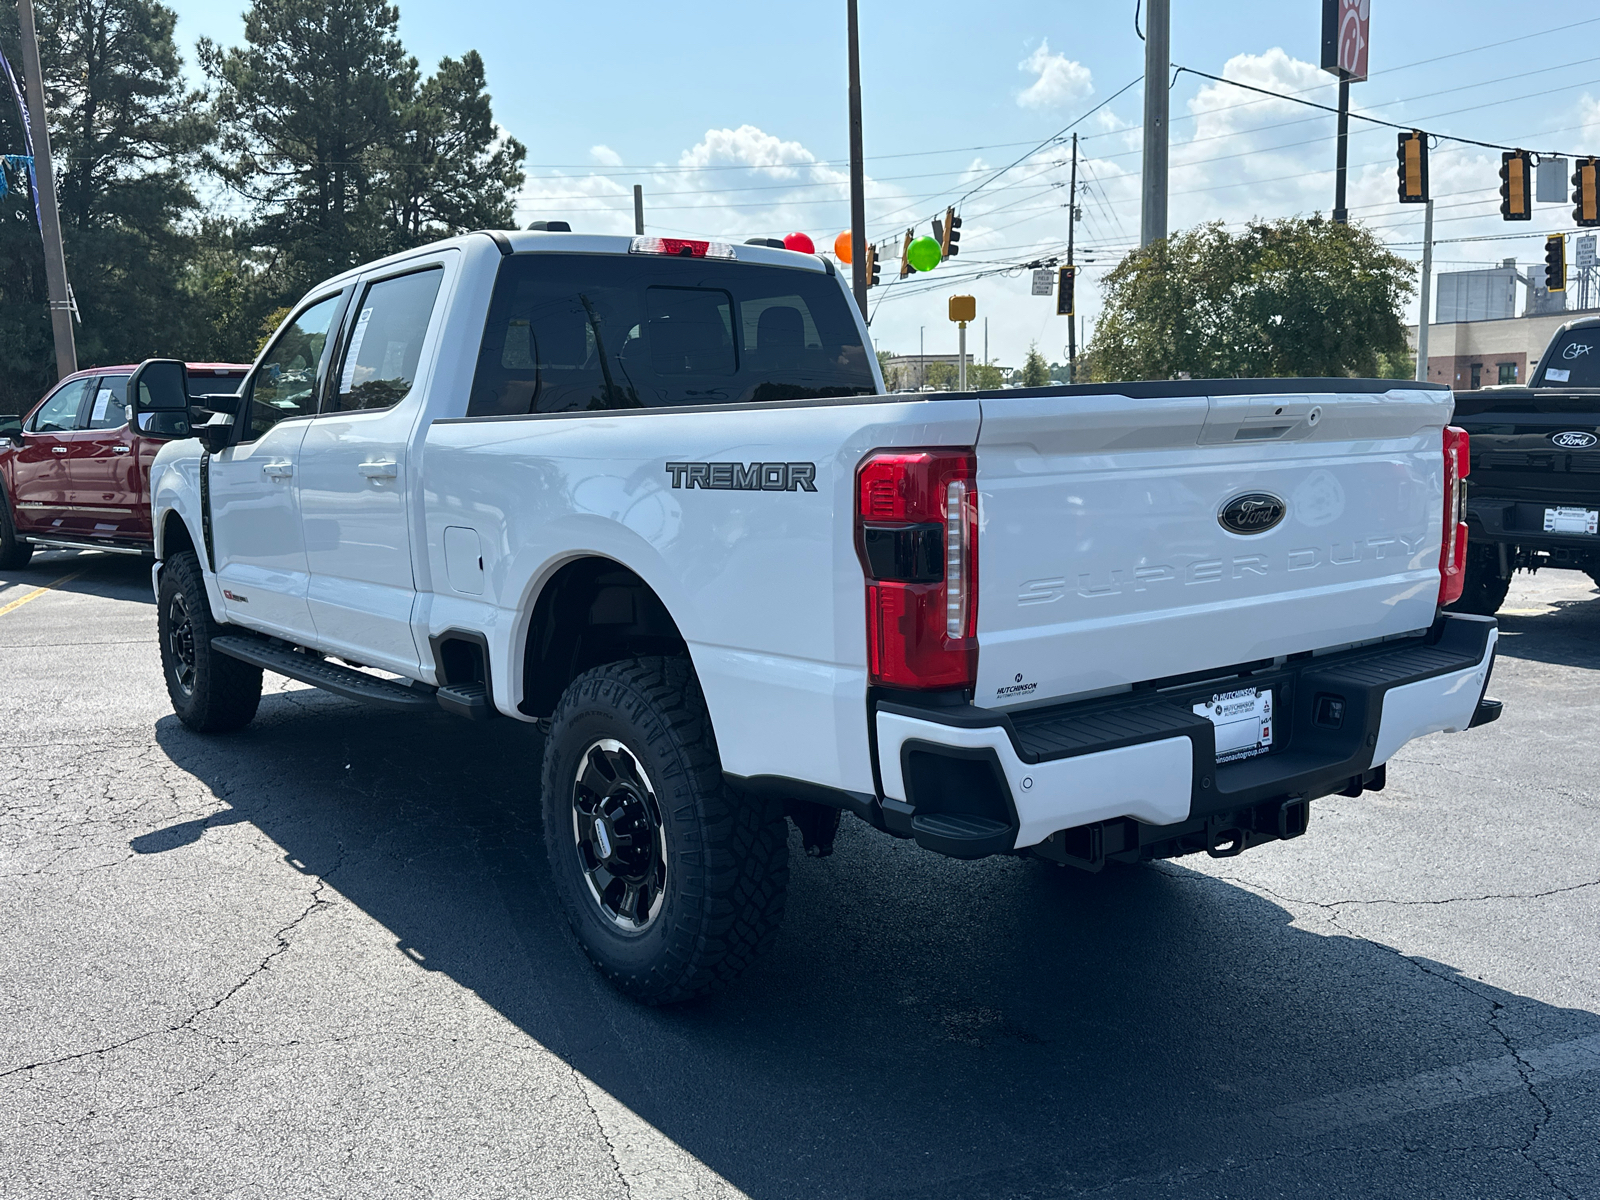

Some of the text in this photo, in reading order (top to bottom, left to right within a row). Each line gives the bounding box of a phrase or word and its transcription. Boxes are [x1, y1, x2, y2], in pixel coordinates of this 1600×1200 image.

[1560, 433, 1589, 446] Ford
[666, 462, 818, 492] TREMOR
[1237, 500, 1274, 524] Ford
[1017, 532, 1426, 606] SUPER DUTY
[996, 682, 1038, 694] HUTCHINSON
[1220, 687, 1256, 701] HUTCHINSON
[1224, 700, 1255, 712] HUTCHINSON
